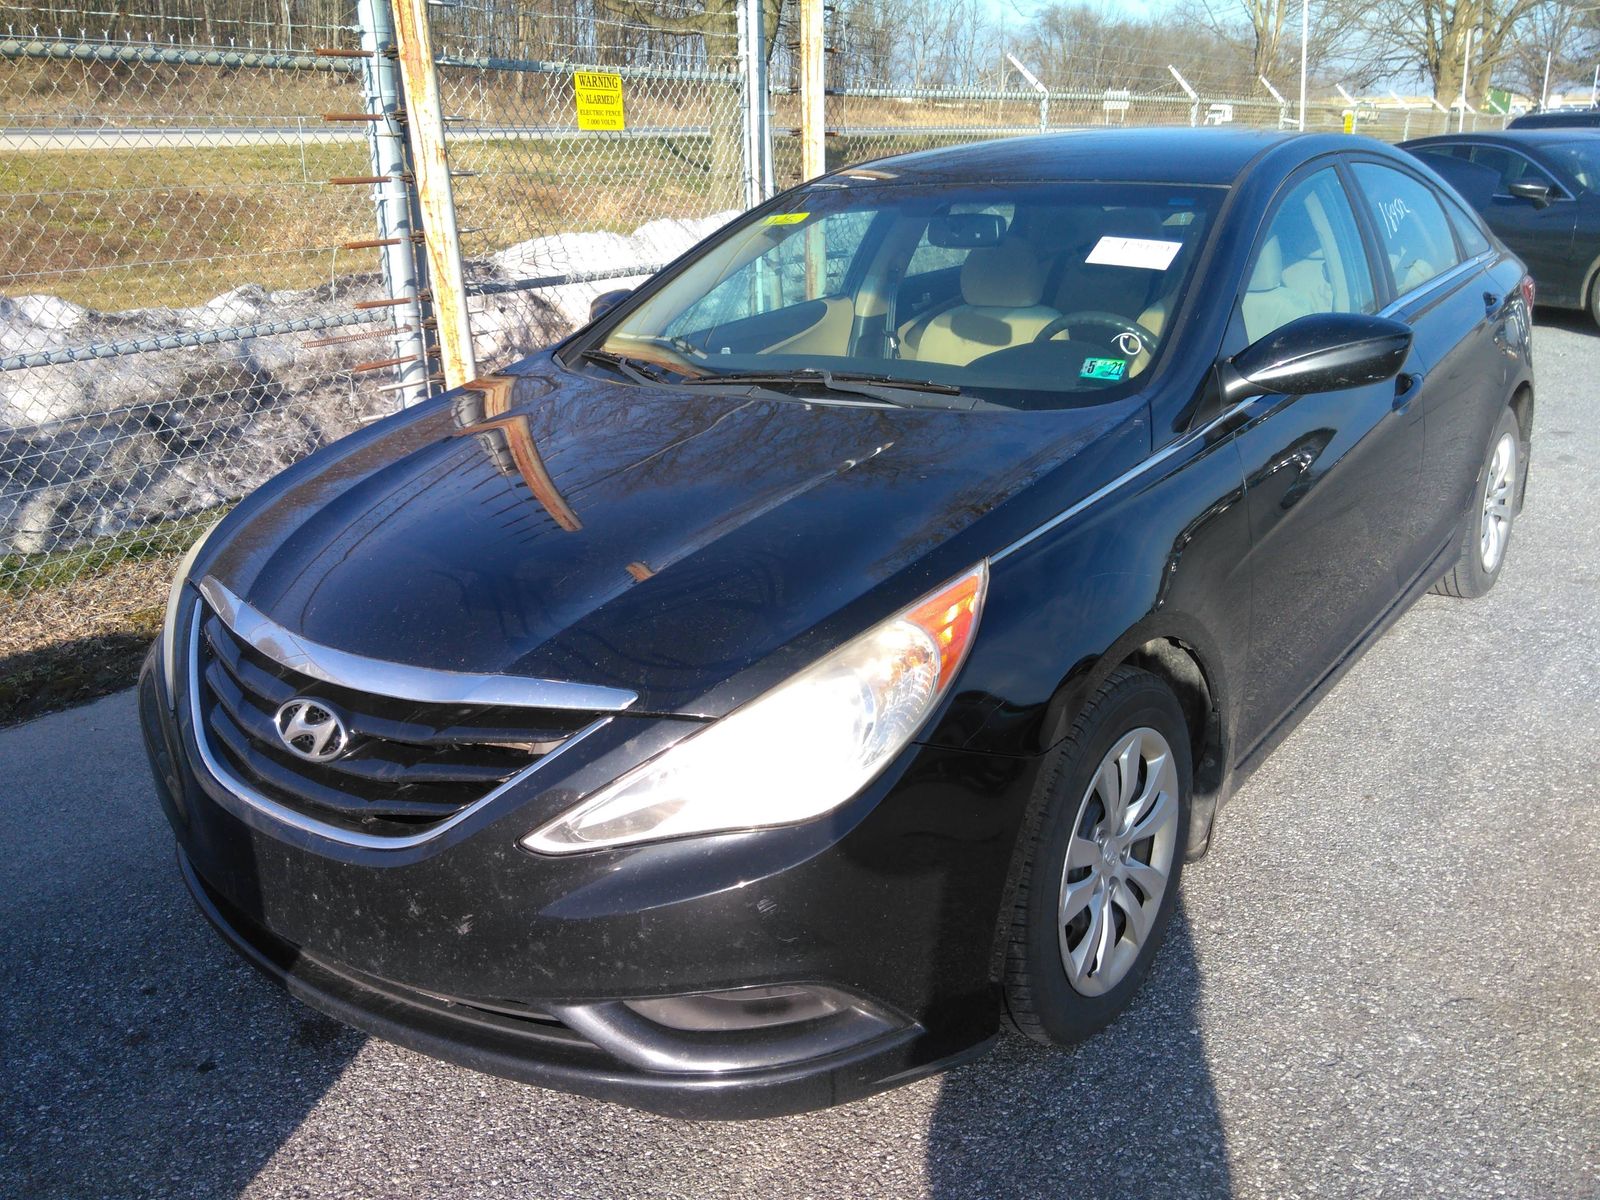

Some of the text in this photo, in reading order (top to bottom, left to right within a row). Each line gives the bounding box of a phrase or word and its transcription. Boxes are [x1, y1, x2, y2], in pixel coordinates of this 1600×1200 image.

[578, 75, 618, 89] WARNING
[585, 94, 615, 105] ALARMED
[1087, 360, 1123, 376] 5 21
